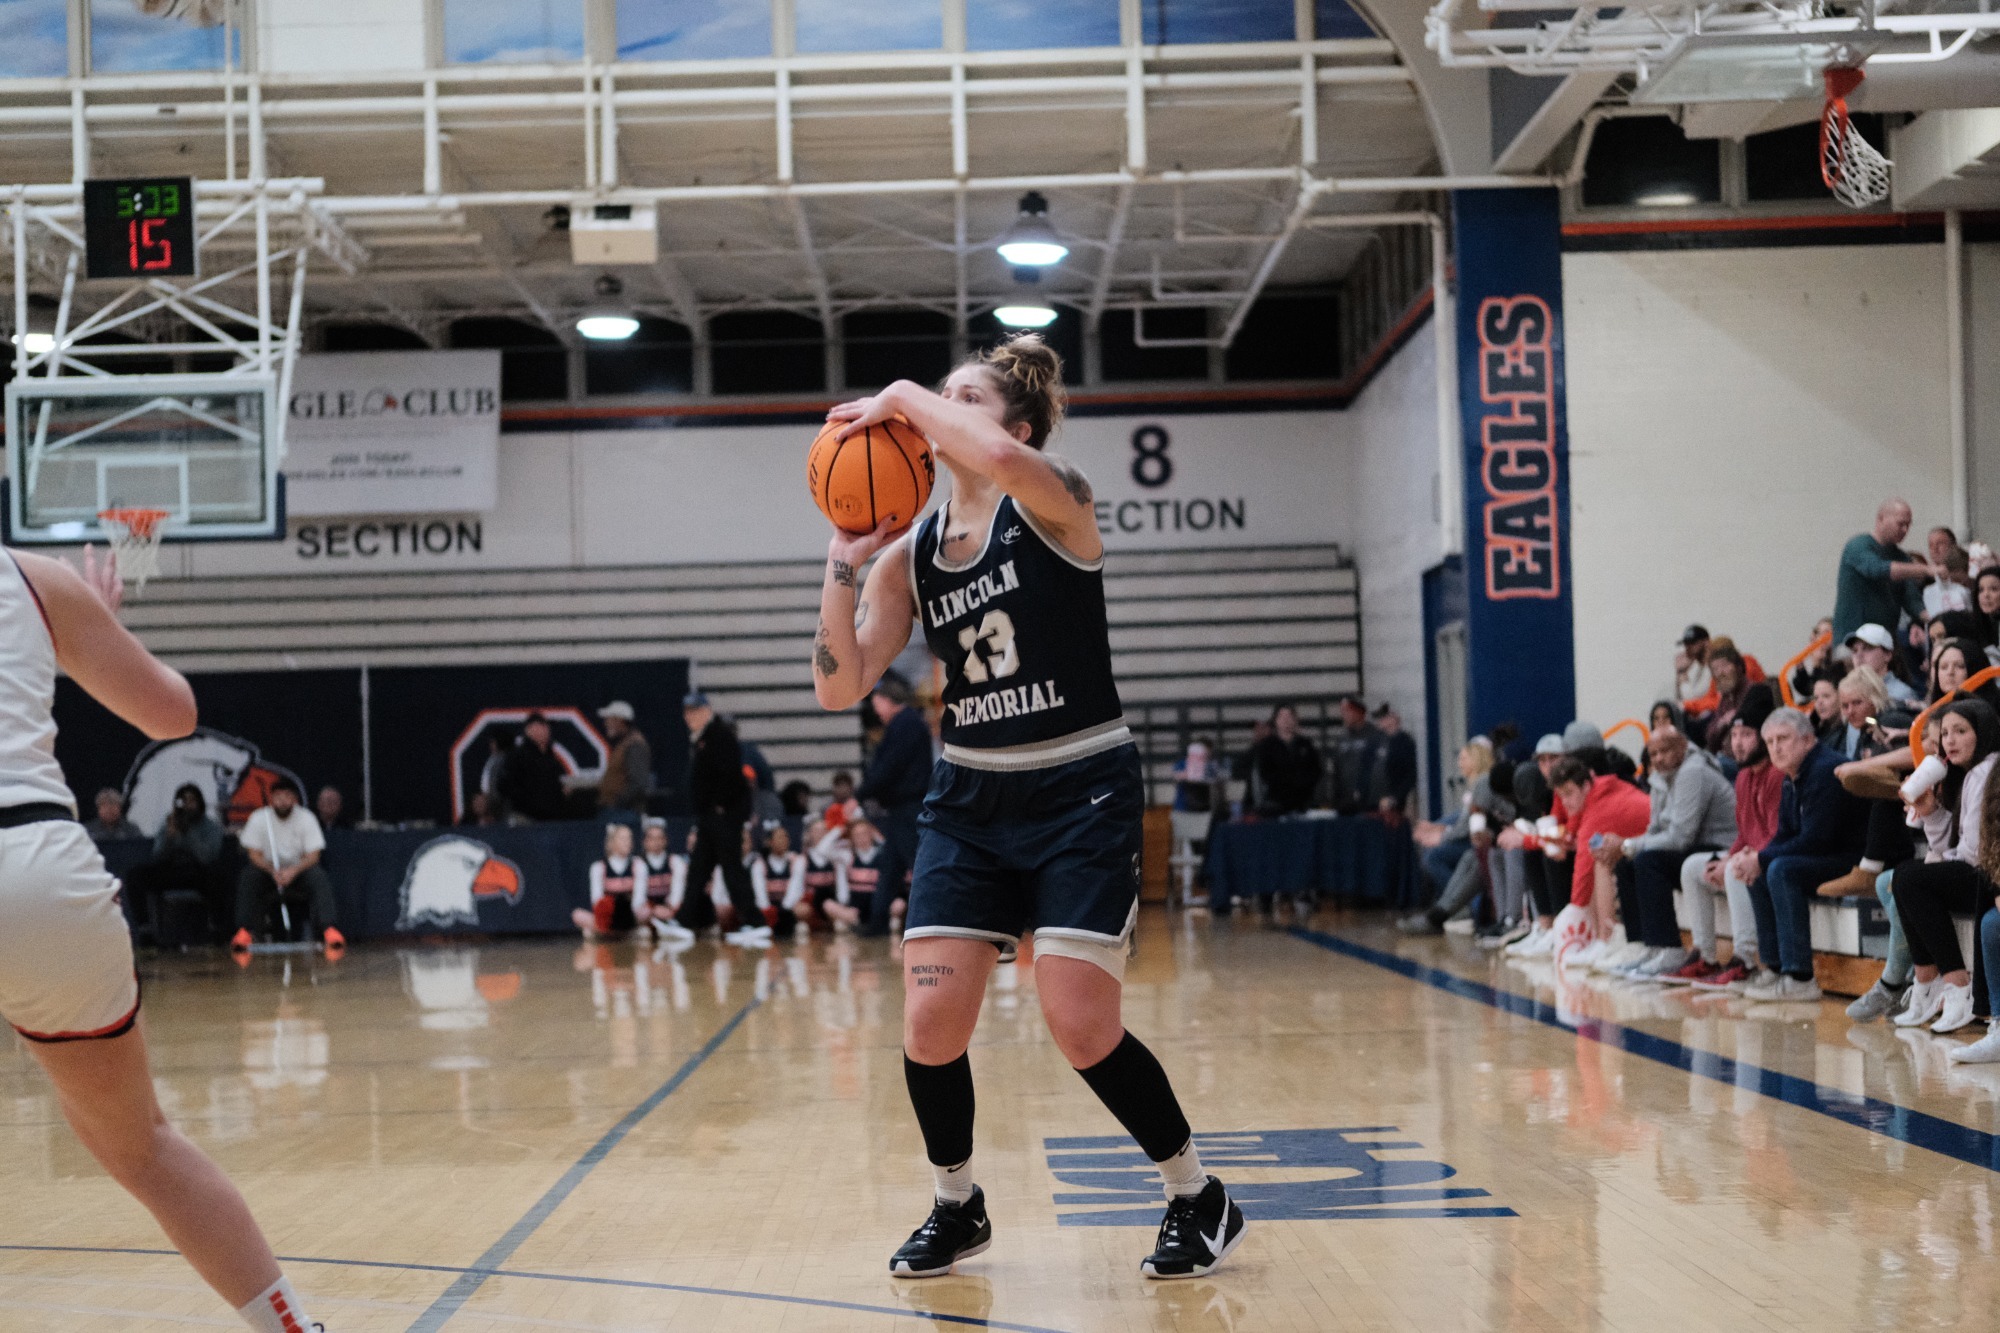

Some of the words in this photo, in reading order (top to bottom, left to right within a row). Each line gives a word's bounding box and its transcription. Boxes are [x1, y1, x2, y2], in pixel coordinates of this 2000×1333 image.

[129, 219, 171, 271] 15
[290, 390, 356, 418] GLE
[403, 388, 494, 417] CLUB
[1131, 424, 1173, 488] 8
[1477, 294, 1560, 600] EAGLES
[297, 521, 483, 558] SECTION
[1096, 498, 1245, 533] ECTION
[928, 560, 1020, 628] LINCOLN
[958, 608, 1020, 684] 13
[947, 679, 1065, 727] MEMORIAL
[911, 964, 954, 975] MEMENTO
[917, 977, 938, 987] MORI
